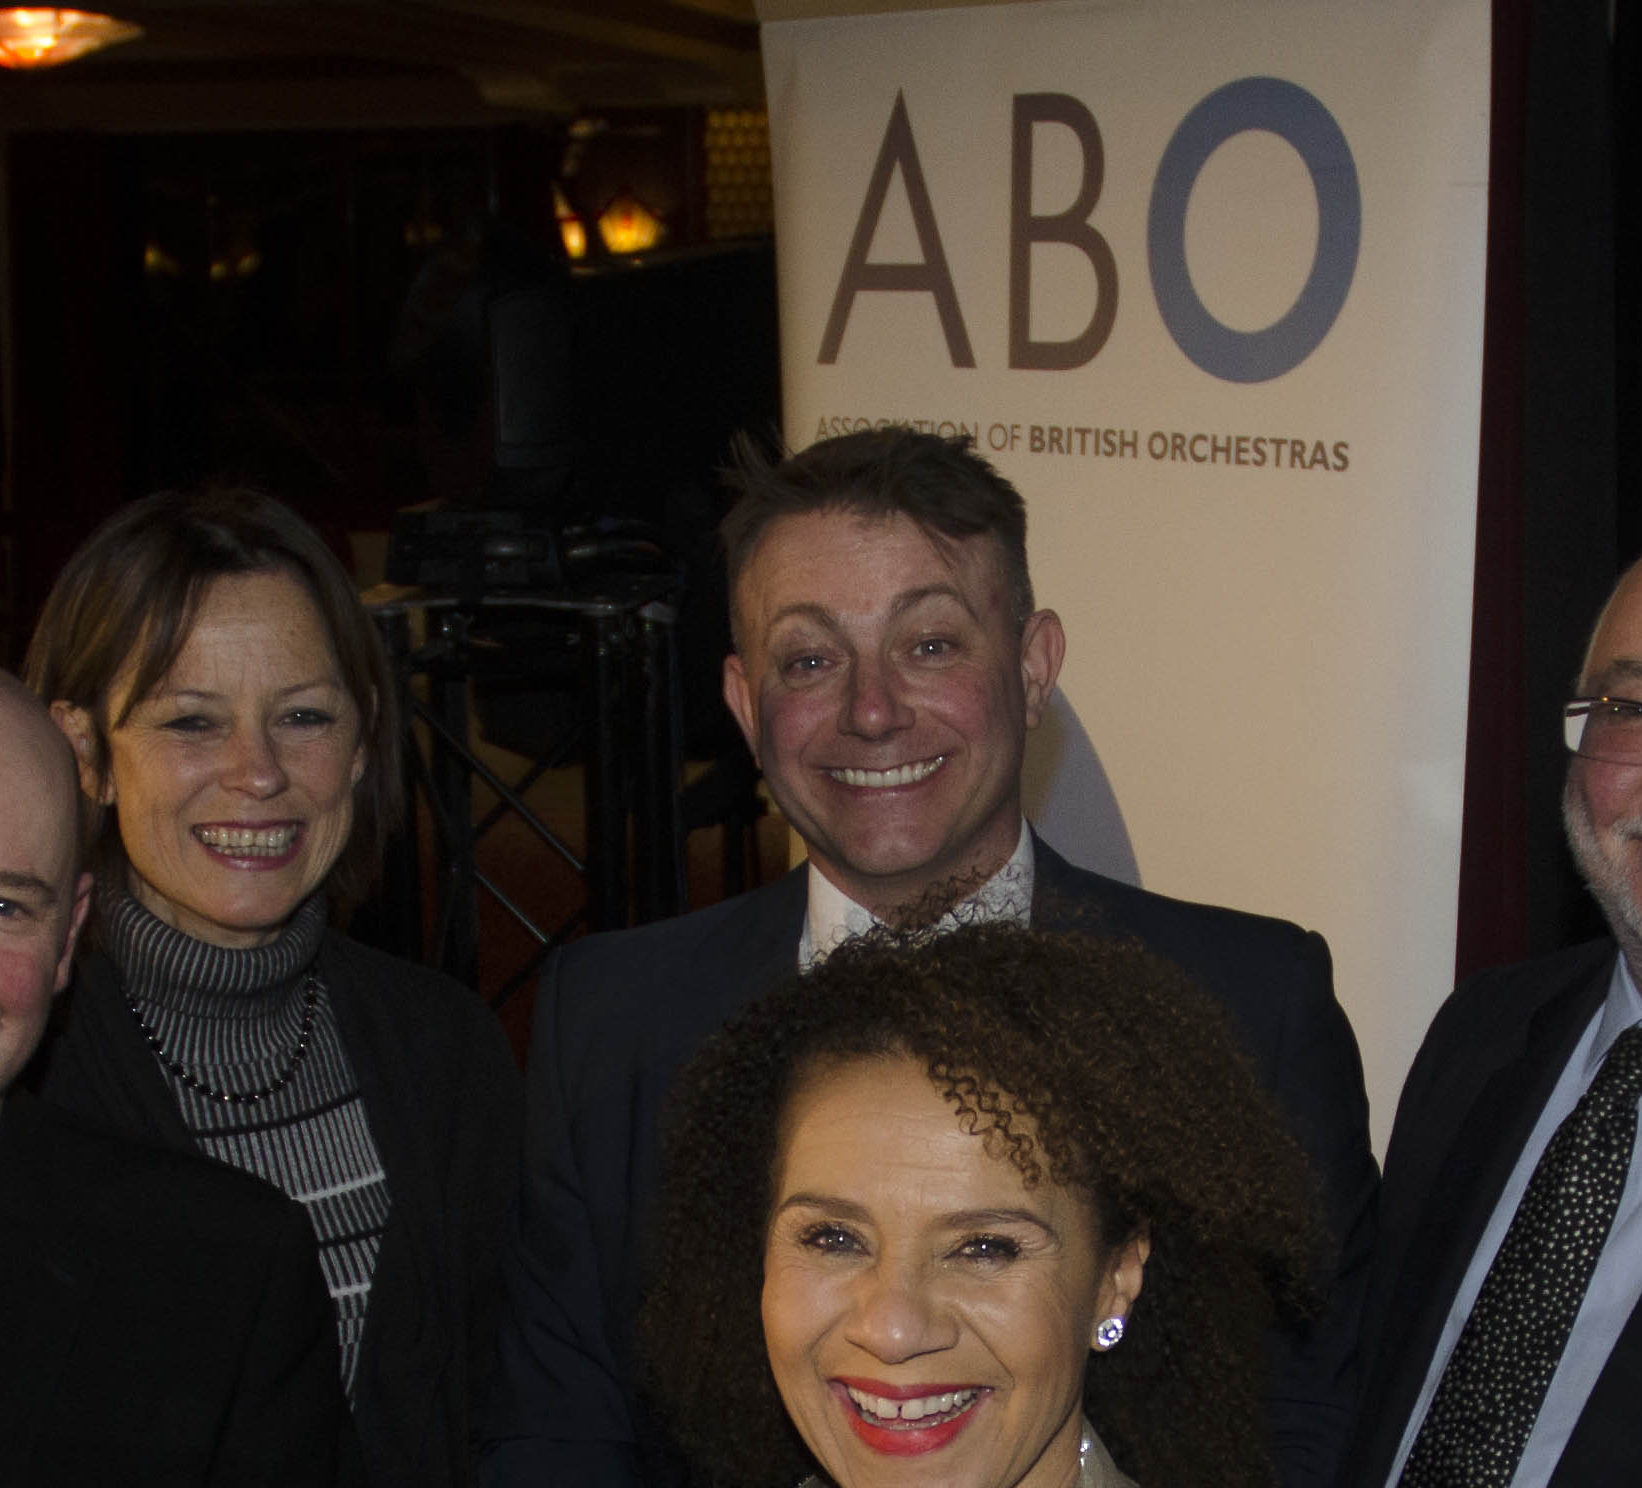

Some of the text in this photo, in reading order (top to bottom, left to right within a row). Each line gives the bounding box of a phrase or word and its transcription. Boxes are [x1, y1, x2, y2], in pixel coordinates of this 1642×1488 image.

[816, 76, 1361, 383] ABO
[988, 423, 1021, 451] OF
[1029, 424, 1139, 459] BRITISH
[1147, 431, 1350, 472] ORCHESTRAS
